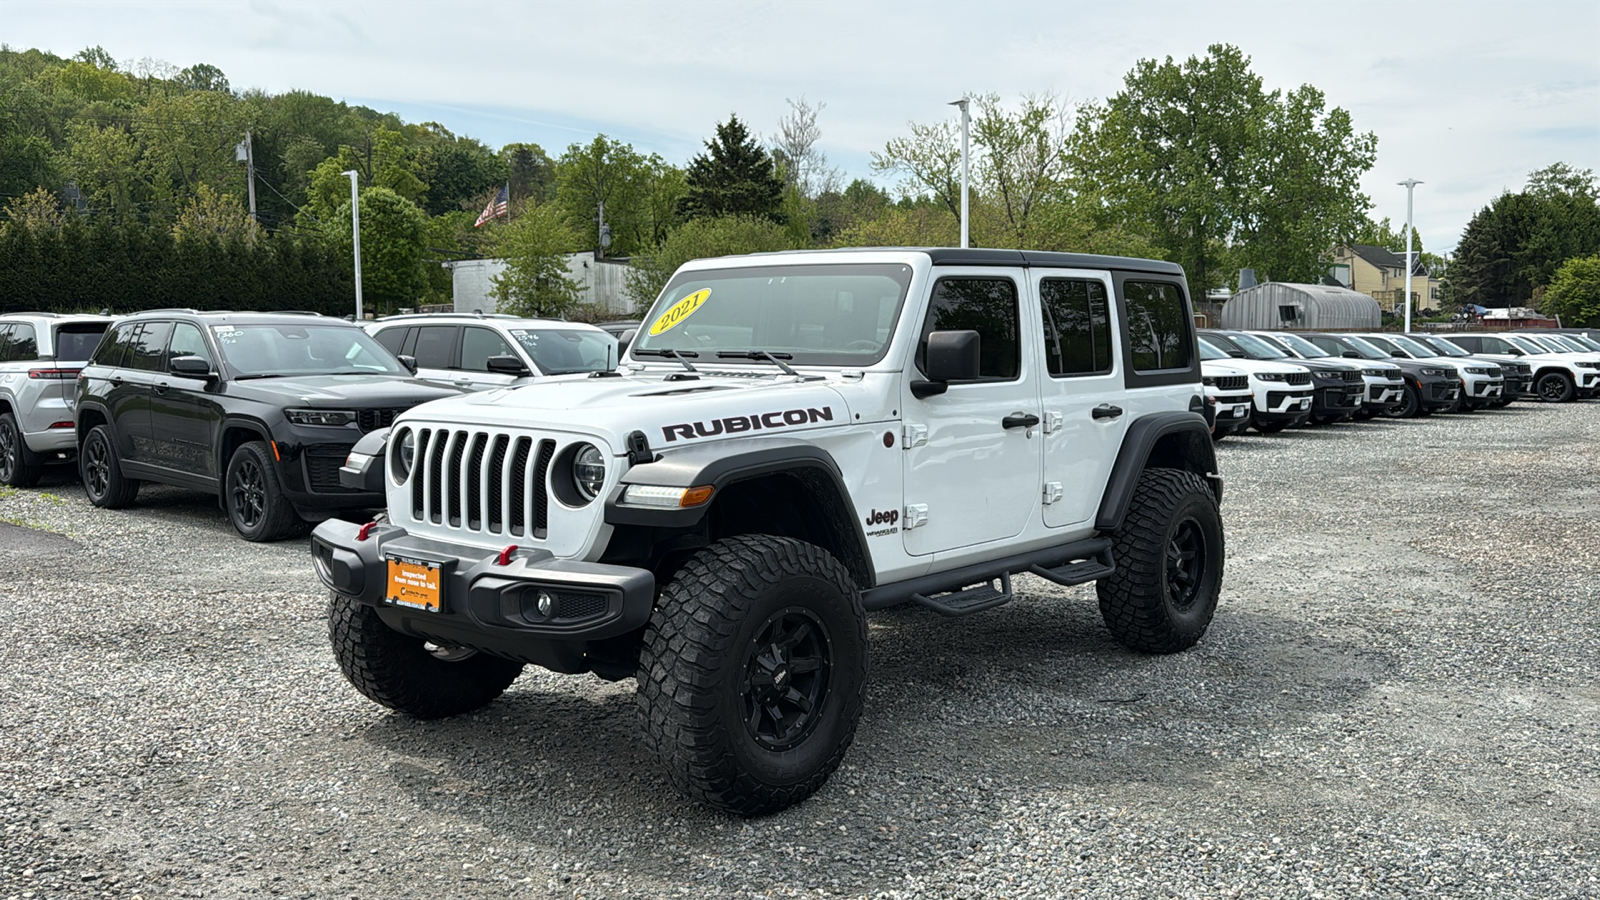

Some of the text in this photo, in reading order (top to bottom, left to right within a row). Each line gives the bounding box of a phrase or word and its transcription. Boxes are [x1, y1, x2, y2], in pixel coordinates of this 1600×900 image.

[660, 293, 700, 331] 2021
[661, 406, 834, 442] RUBICON
[866, 508, 899, 526] Jeep
[394, 575, 407, 584] from
[420, 580, 426, 588] to
[401, 569, 427, 580] Inspected
